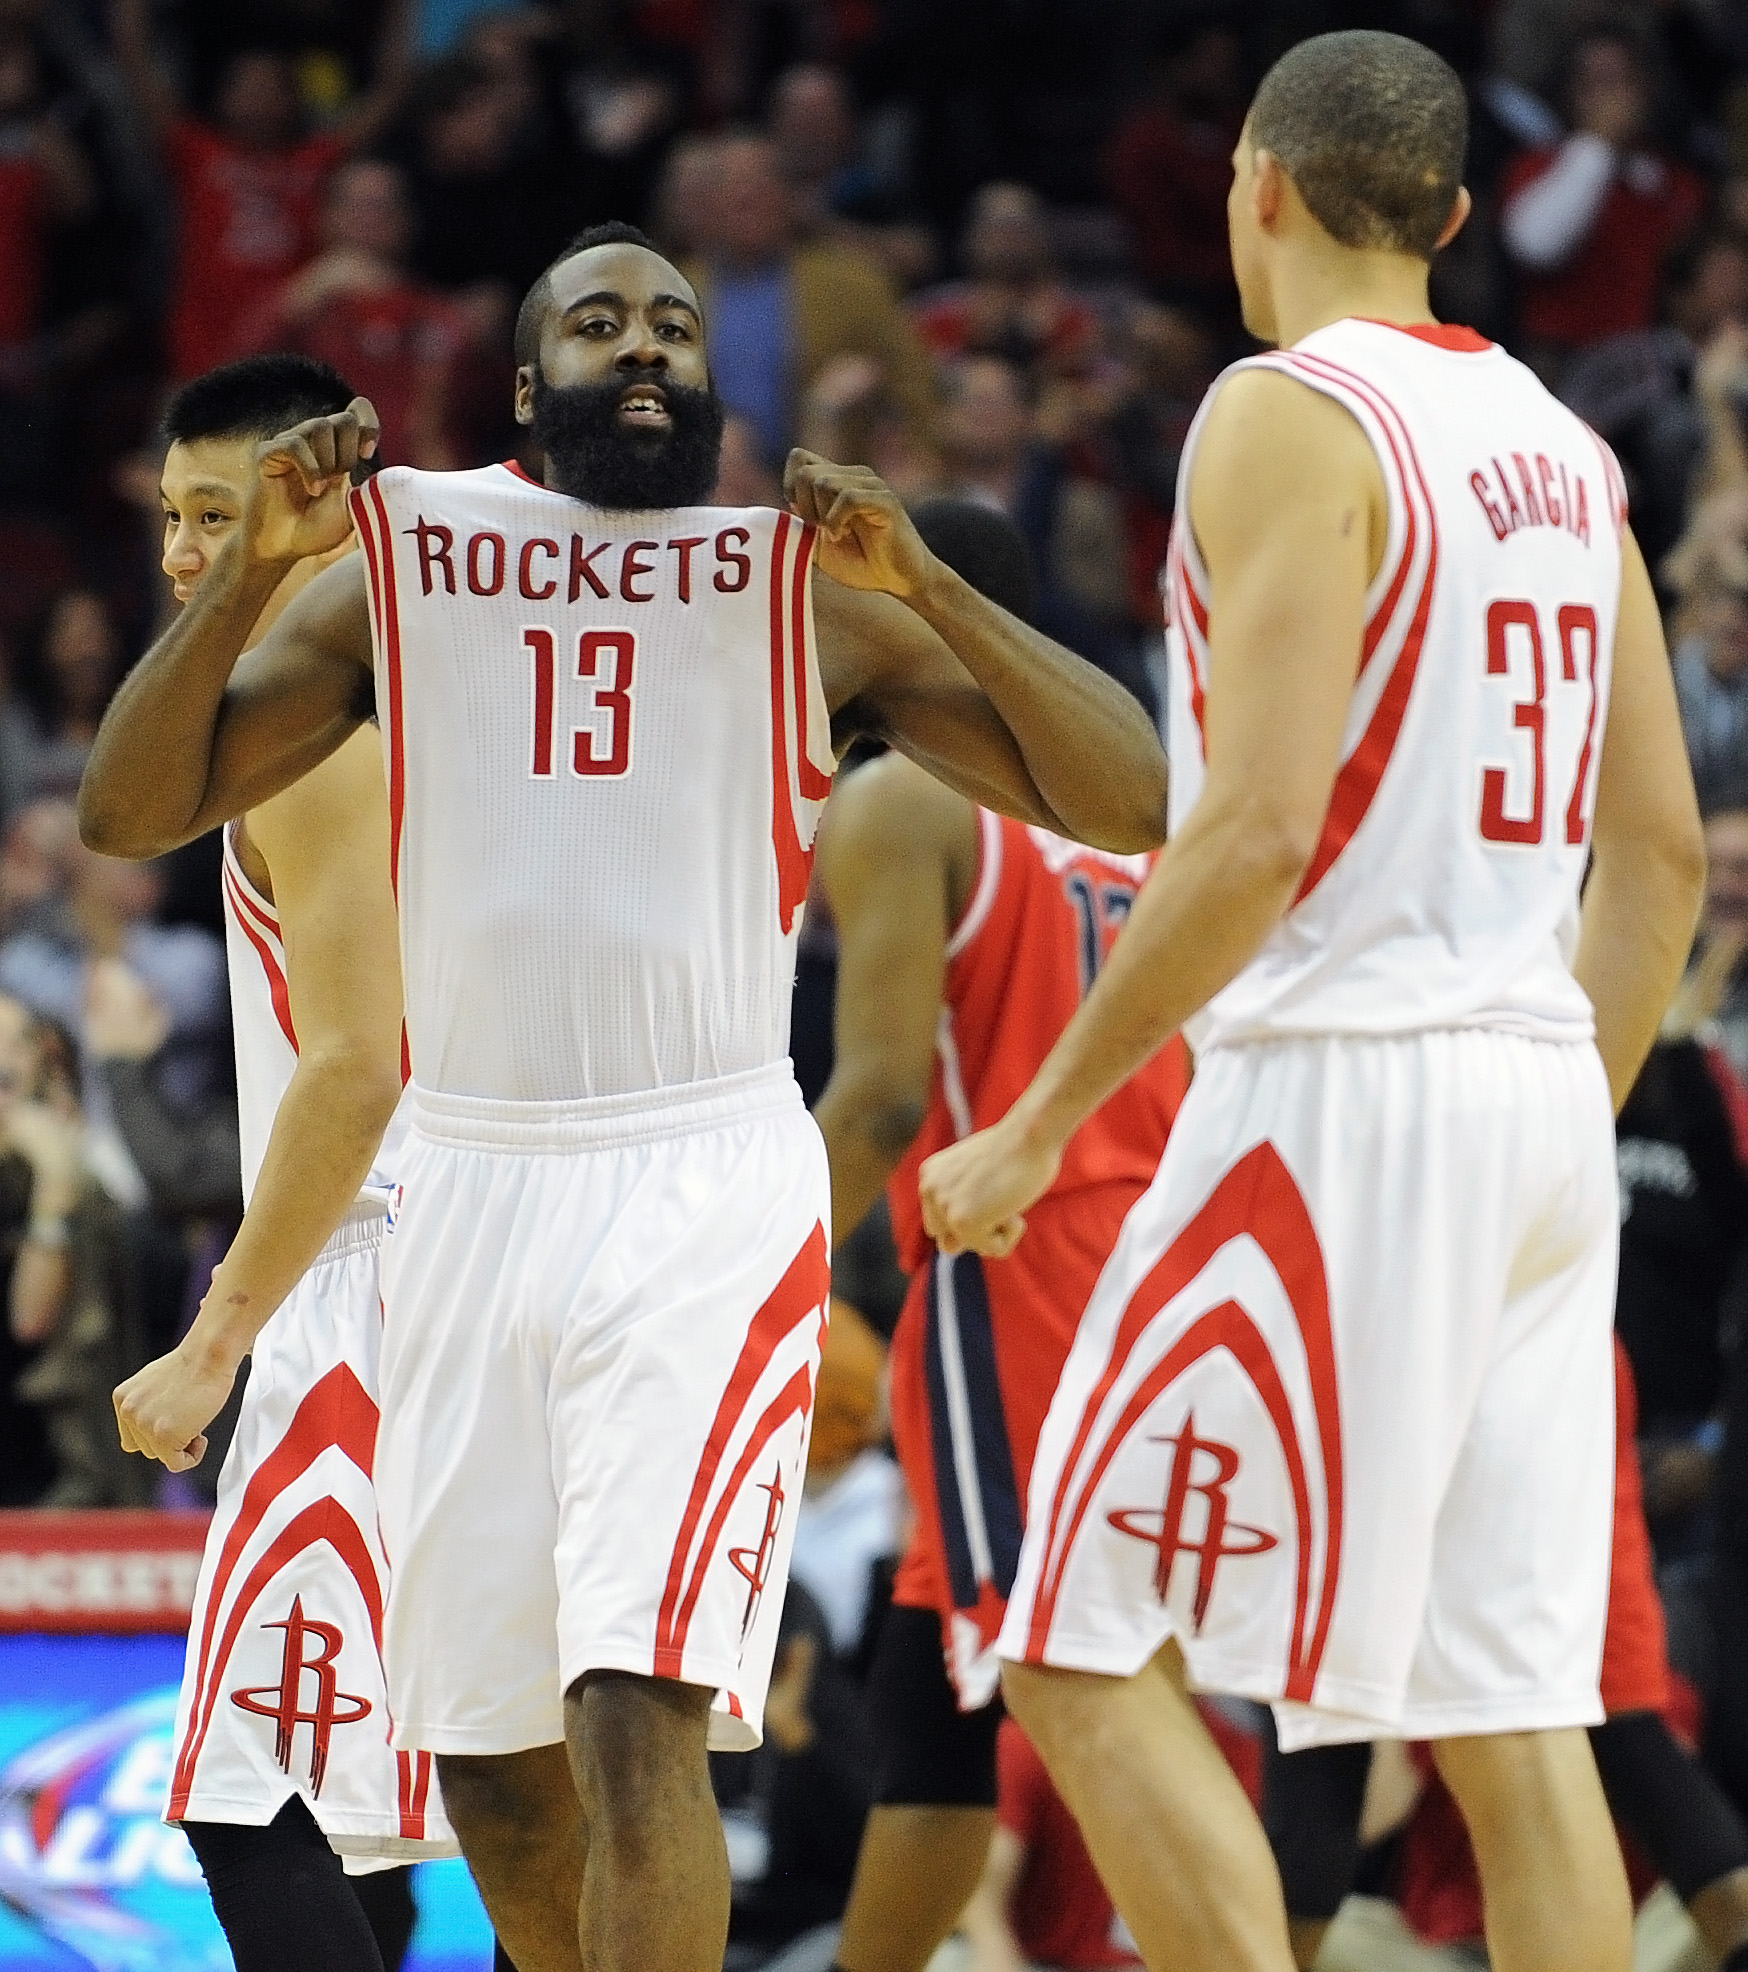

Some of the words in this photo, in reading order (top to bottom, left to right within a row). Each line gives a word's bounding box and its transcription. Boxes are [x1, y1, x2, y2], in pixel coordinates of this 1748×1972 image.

[402, 513, 752, 605] ROCKETS
[1468, 452, 1590, 549] GARCIA
[519, 624, 640, 781] 13
[1480, 599, 1599, 846] 32
[1066, 872, 1137, 1001] 1
